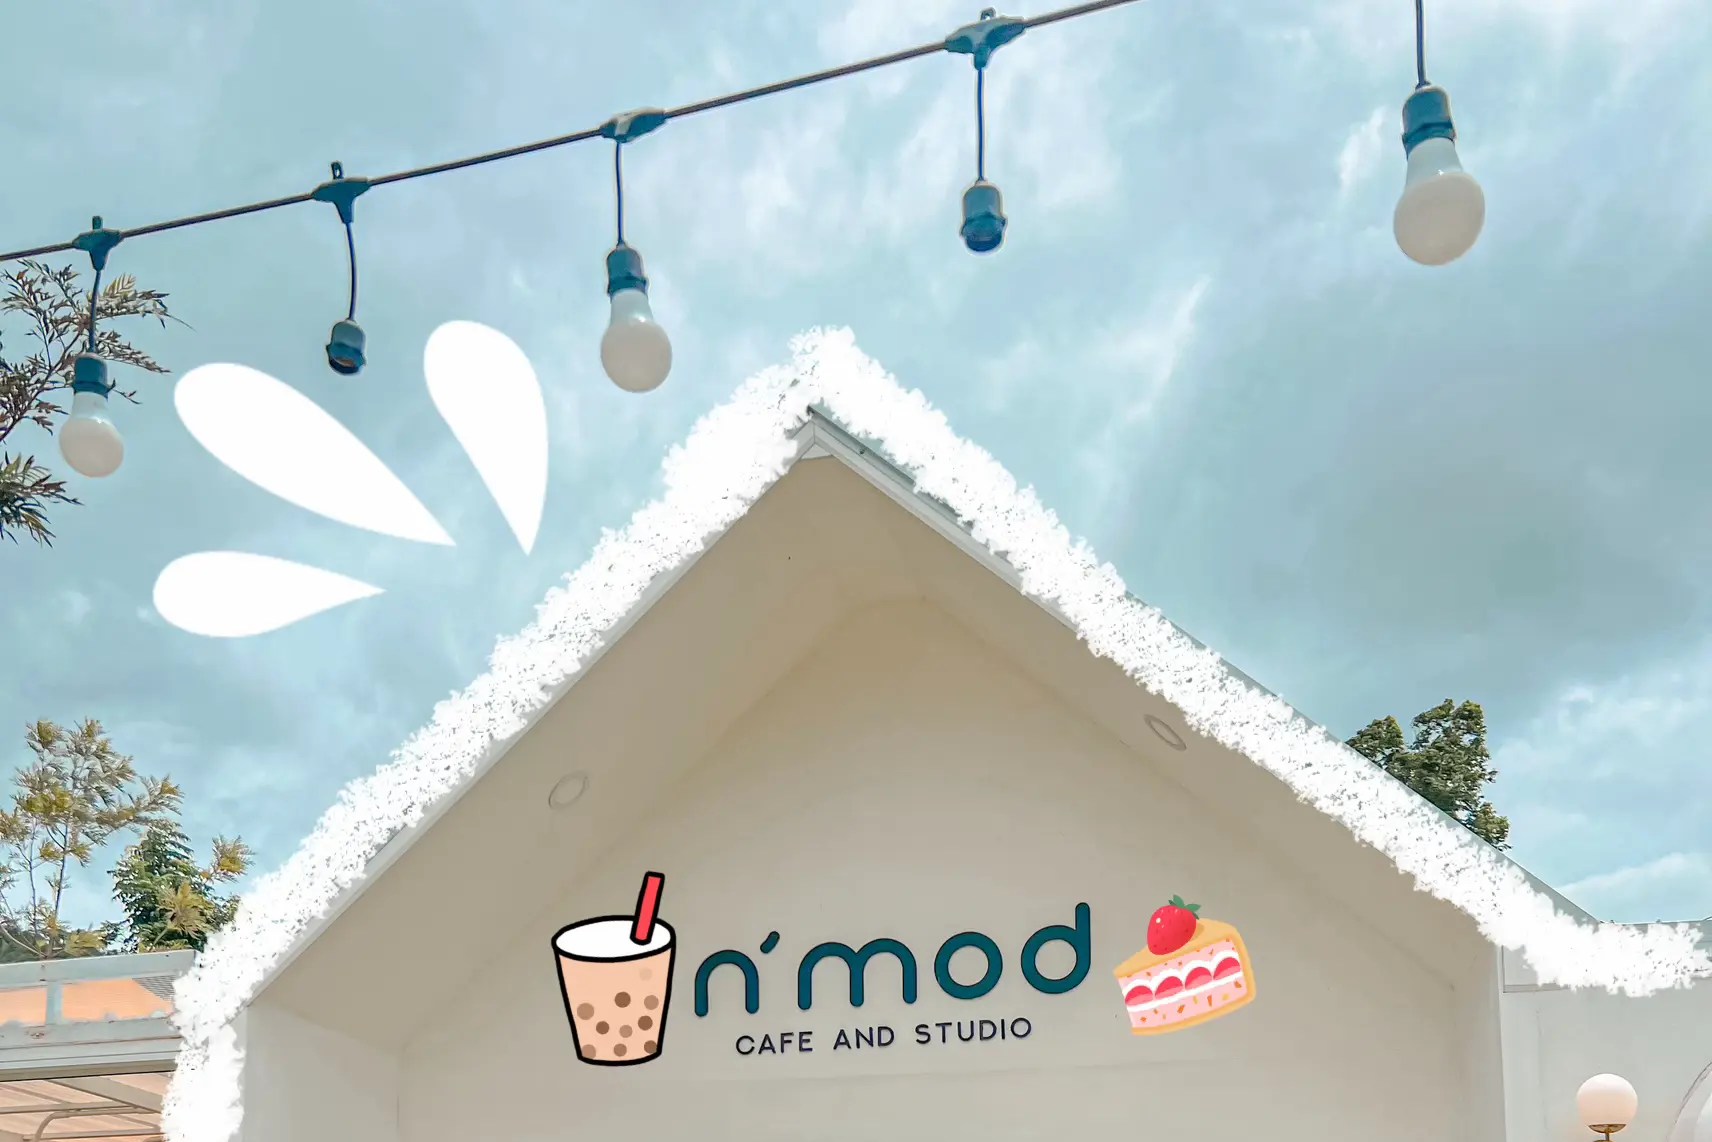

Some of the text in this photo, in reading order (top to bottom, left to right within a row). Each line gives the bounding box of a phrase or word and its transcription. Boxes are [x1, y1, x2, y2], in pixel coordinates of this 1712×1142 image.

[695, 902, 1091, 1017] n'mod
[735, 1017, 1032, 1055] CAFE AND STUDIO
